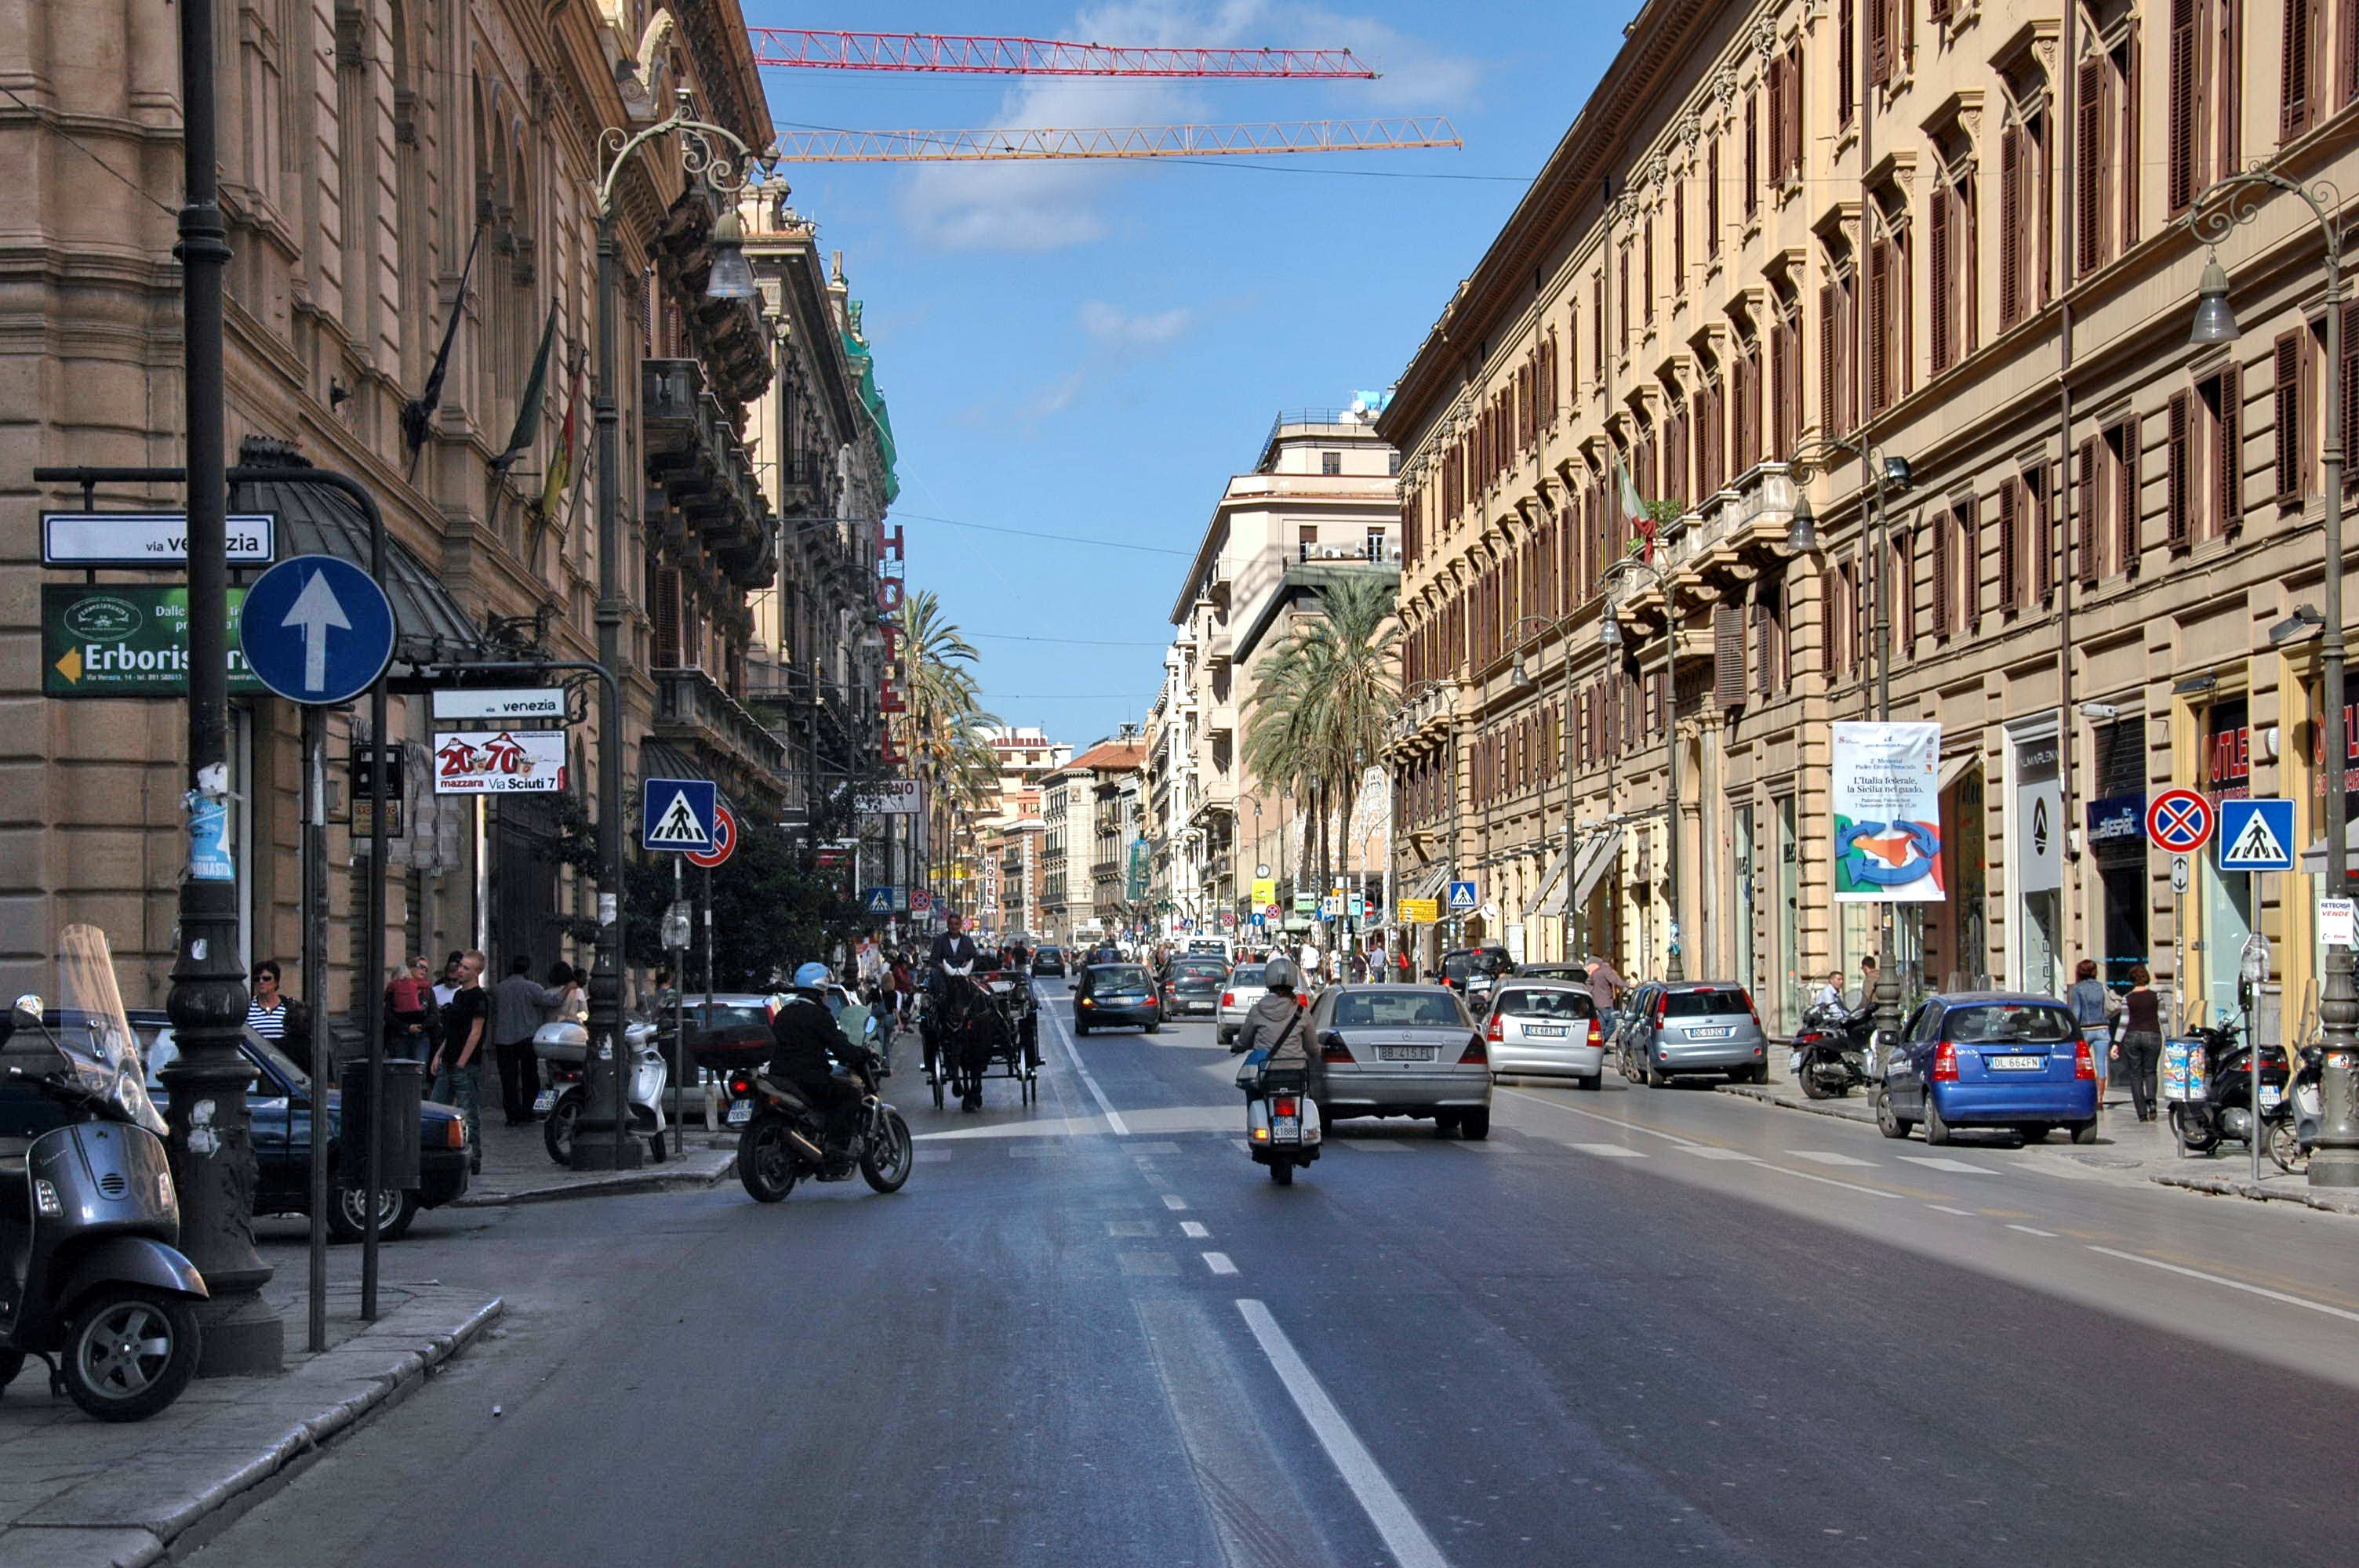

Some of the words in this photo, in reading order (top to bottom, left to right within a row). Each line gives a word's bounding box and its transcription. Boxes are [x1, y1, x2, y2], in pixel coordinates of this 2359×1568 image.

[146, 540, 164, 552] via
[168, 533, 259, 552] vezia
[877, 524, 908, 764] HOTEL
[503, 699, 556, 712] venezia
[438, 747, 475, 776] 20
[485, 744, 522, 774] 70
[440, 779, 485, 788] mazzara
[488, 778, 506, 790] Via
[507, 777, 545, 789] Sciuti
[547, 777, 556, 789] 7
[1853, 776, 1883, 785] L'Italia
[1885, 776, 1918, 786] federale,
[1847, 785, 1855, 793] la
[1856, 785, 1882, 793] Sicilia
[1885, 785, 1898, 793] nel
[1899, 785, 1925, 794] guado.
[986, 858, 994, 906] HOTEL
[1399, 1047, 1417, 1058] 415
[1994, 1057, 2006, 1068] DL
[2008, 1056, 2039, 1068] 664FN
